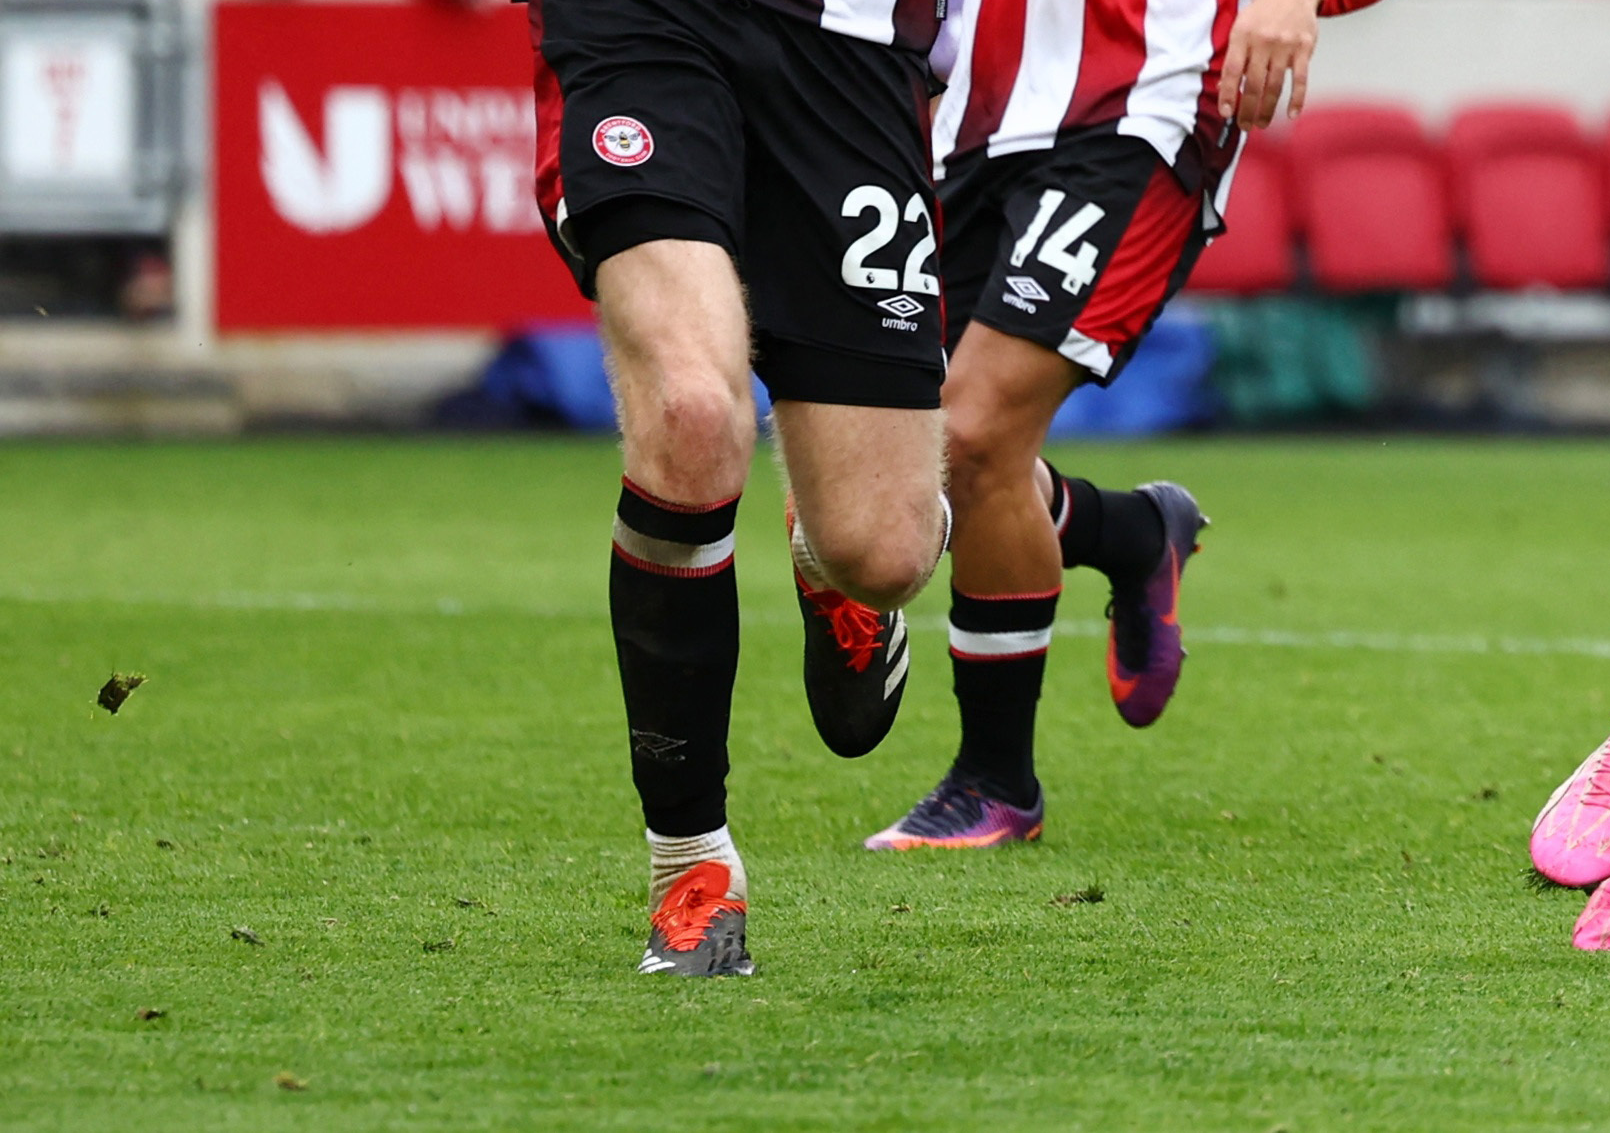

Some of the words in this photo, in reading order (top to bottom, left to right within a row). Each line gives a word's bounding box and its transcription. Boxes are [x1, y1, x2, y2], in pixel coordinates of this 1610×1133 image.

[841, 185, 940, 297] 22
[1010, 188, 1106, 297] 14
[881, 317, 918, 332] umbro
[1002, 291, 1037, 314] umbro
